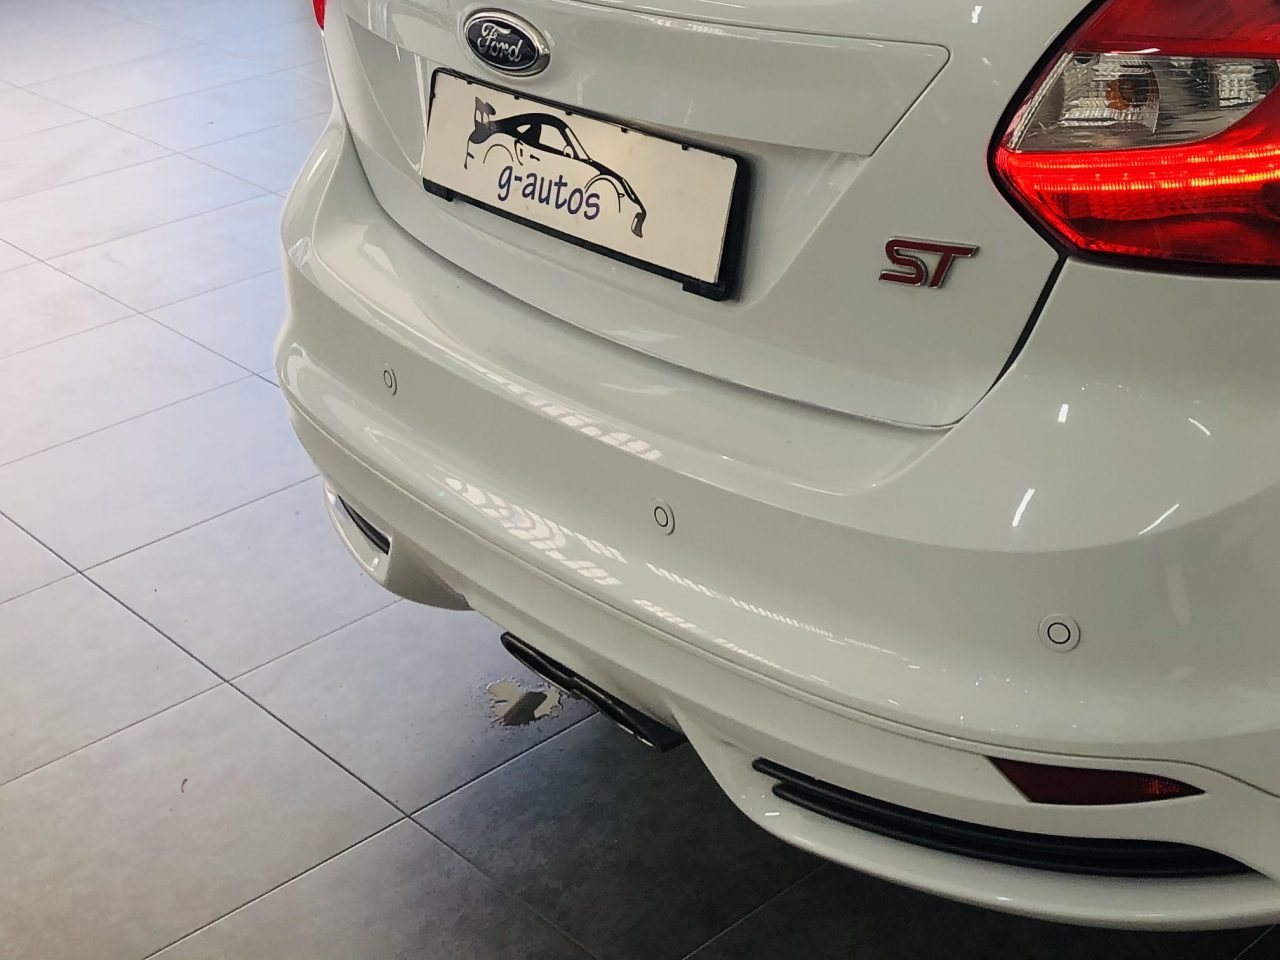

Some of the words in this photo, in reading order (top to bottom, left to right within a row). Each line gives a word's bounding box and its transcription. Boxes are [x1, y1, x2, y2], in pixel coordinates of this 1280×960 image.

[477, 22, 523, 62] Ford
[497, 165, 601, 220] g-autos
[879, 236, 980, 288] ST
